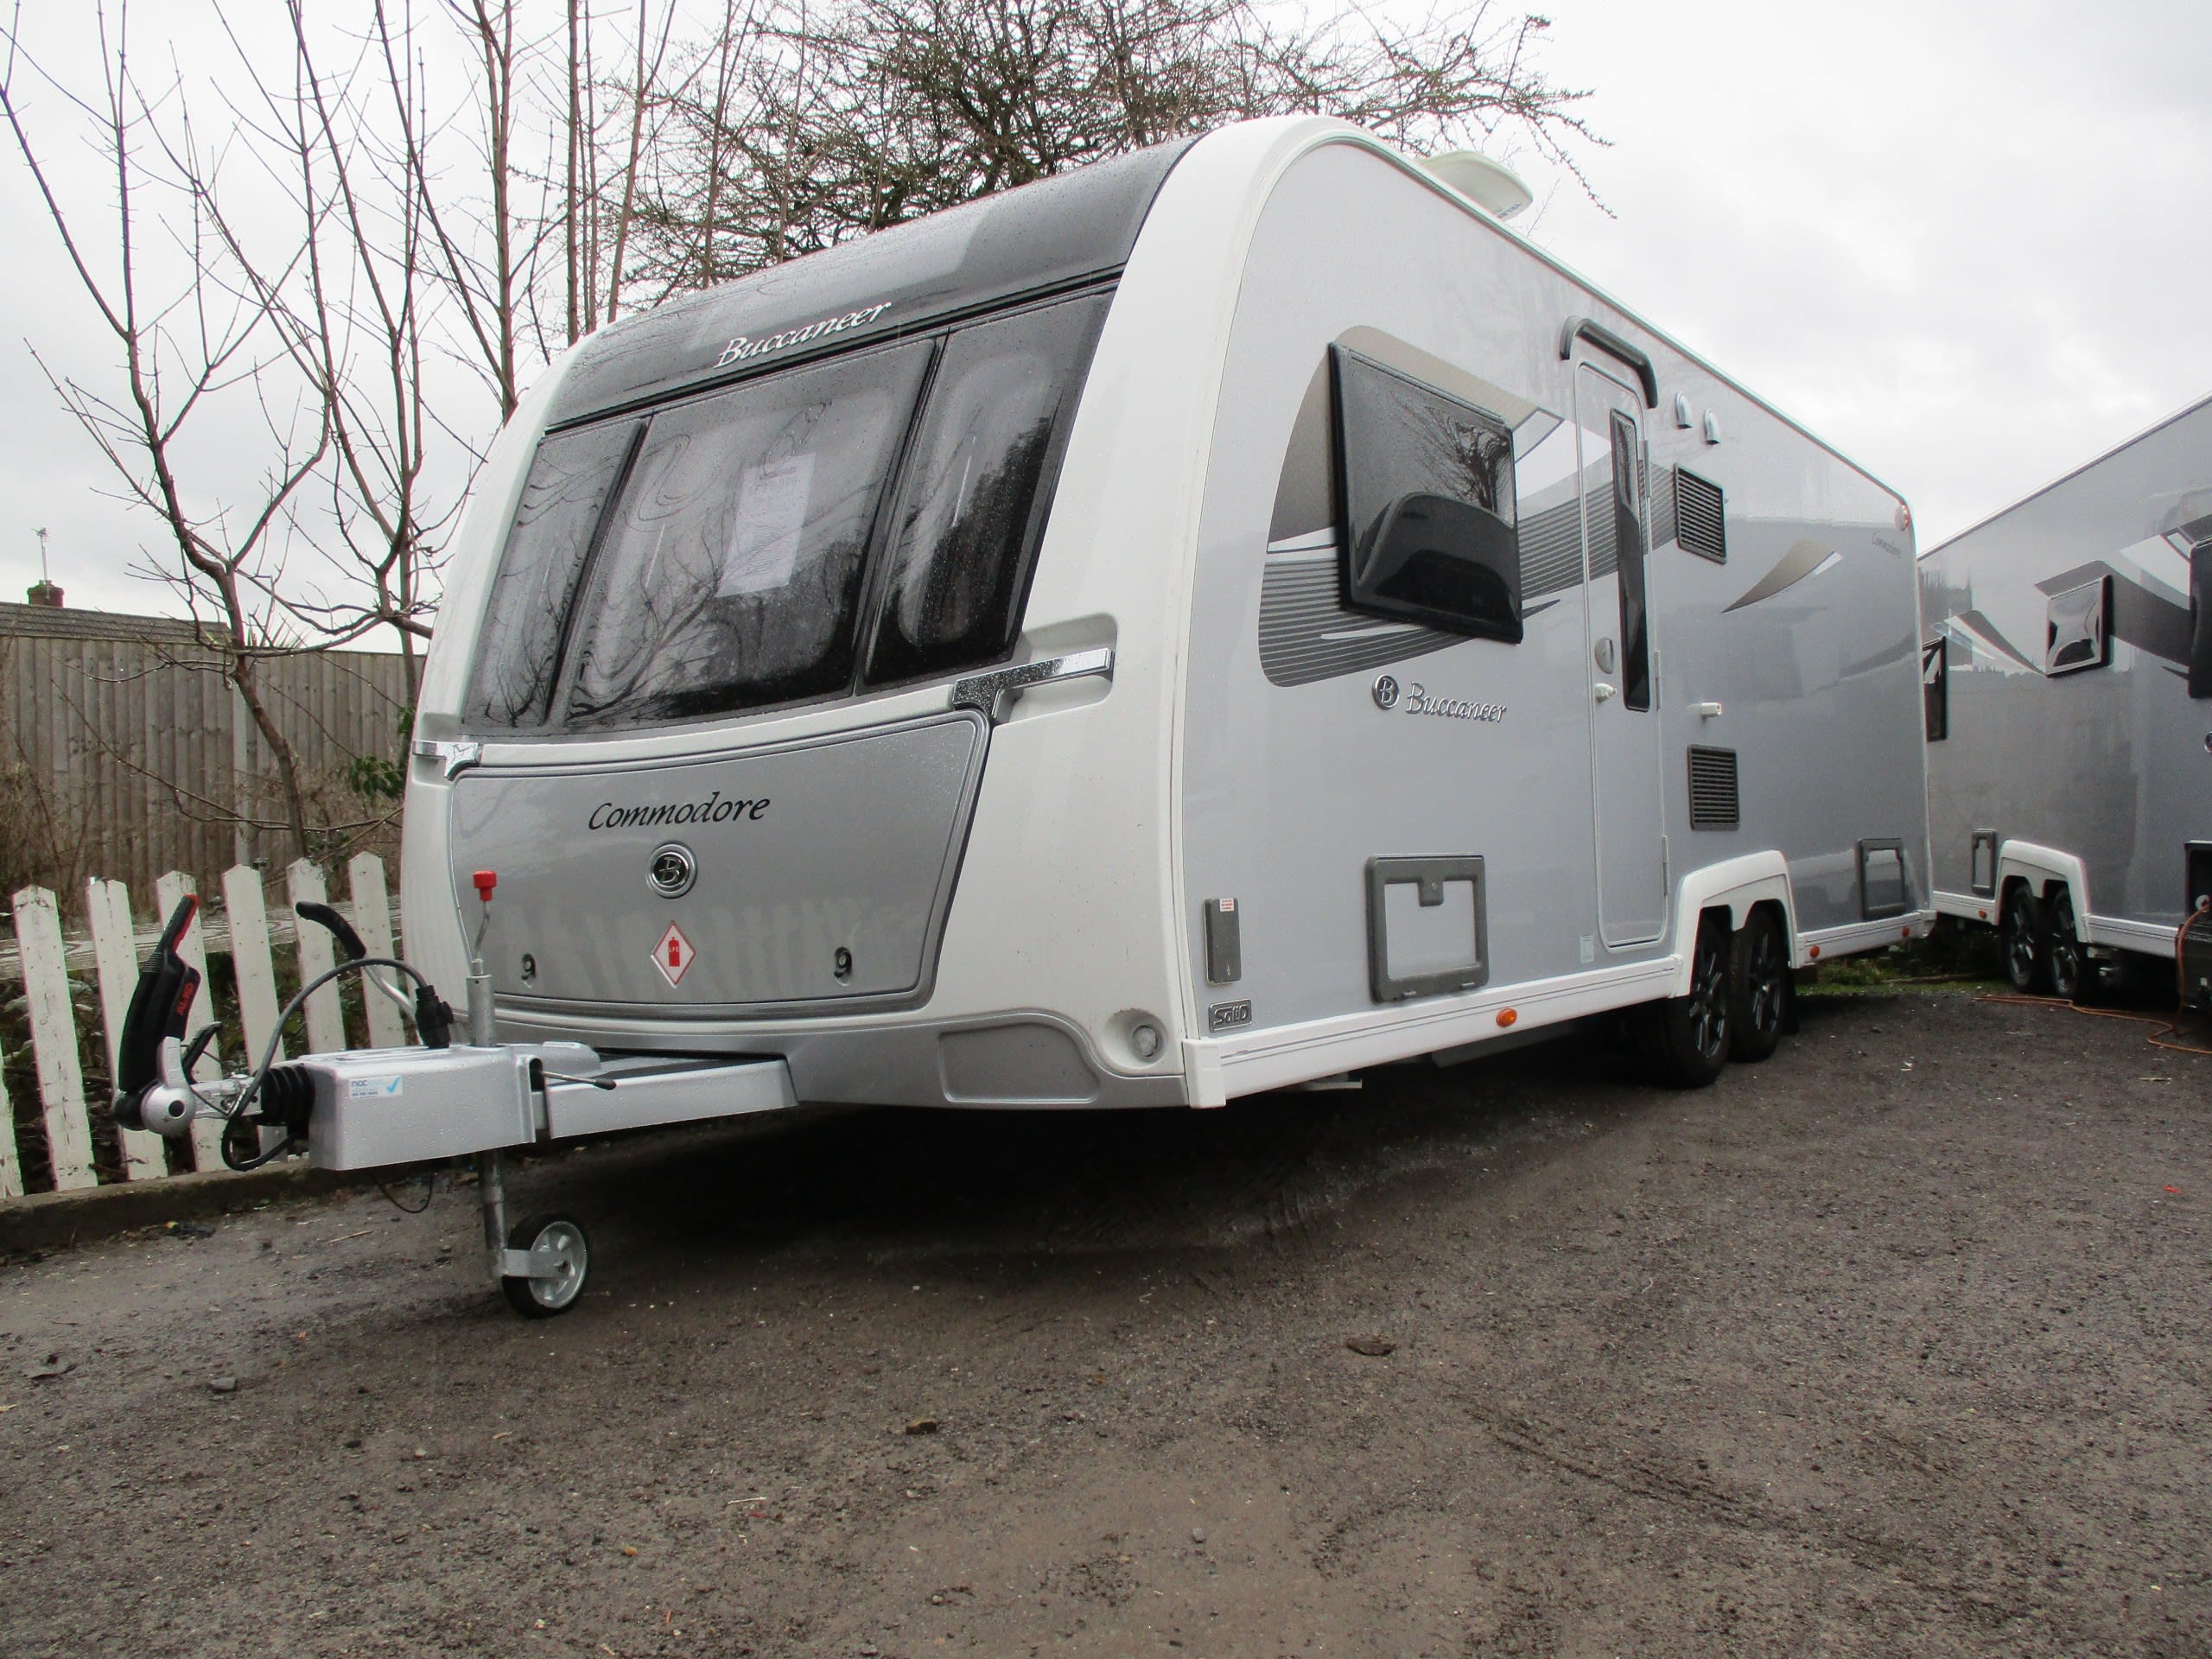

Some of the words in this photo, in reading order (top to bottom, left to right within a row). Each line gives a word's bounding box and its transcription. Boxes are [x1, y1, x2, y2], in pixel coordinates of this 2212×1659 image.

[714, 302, 892, 369] Buccaneer
[1406, 681, 1507, 723] Buccaneer
[588, 791, 771, 830] Commodore
